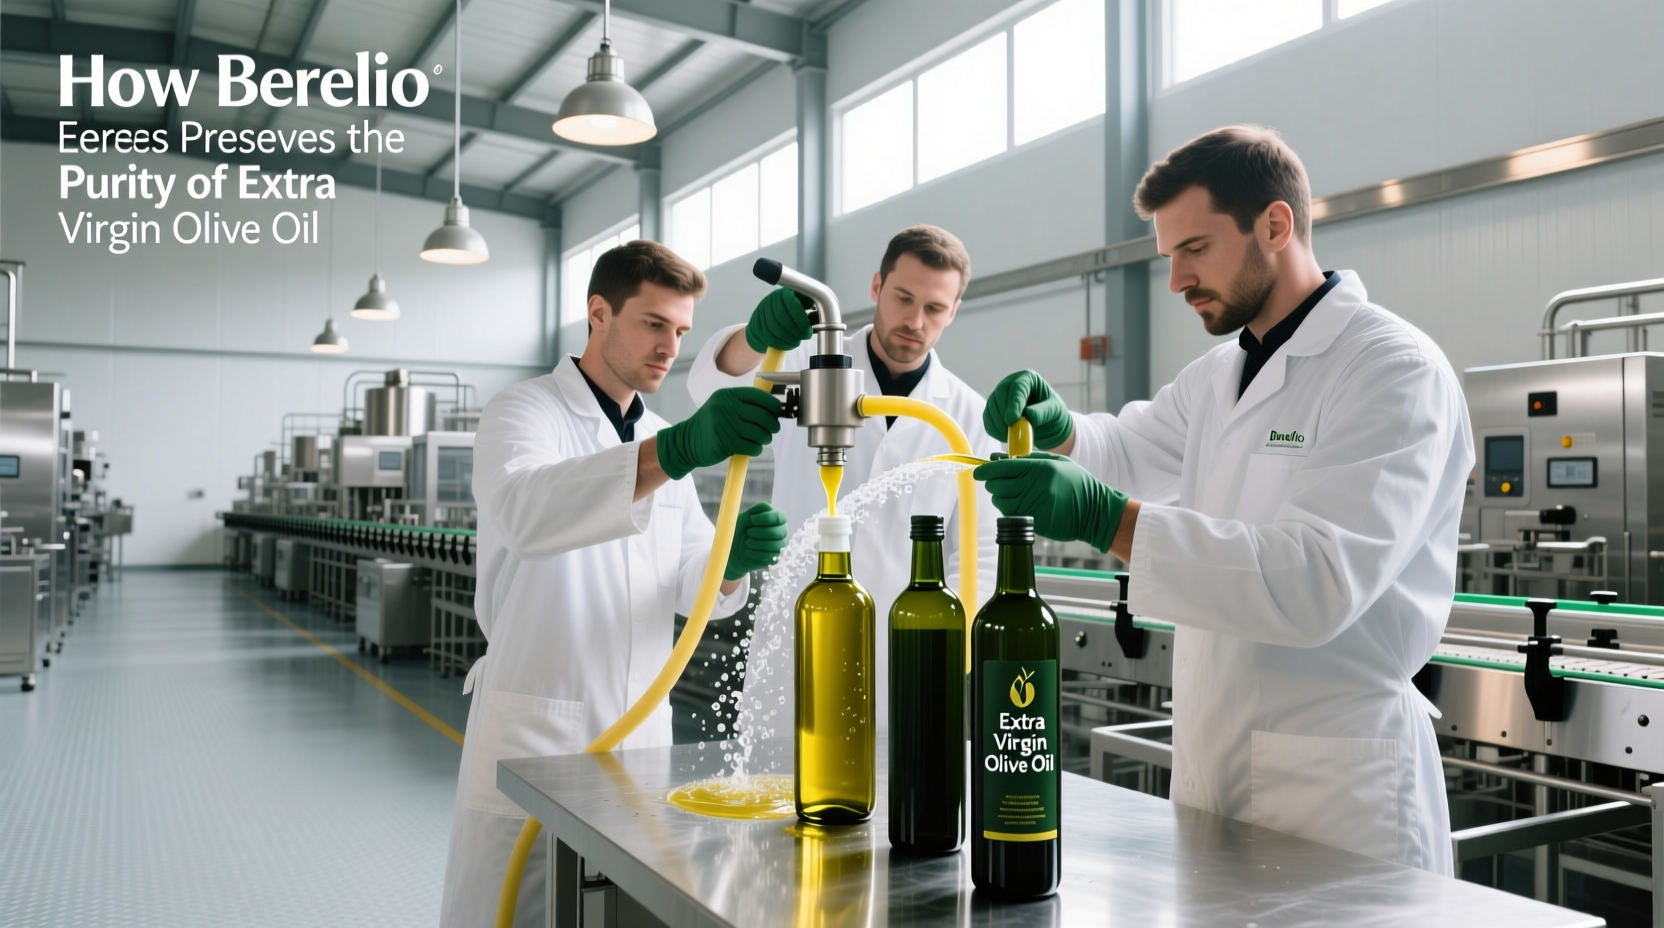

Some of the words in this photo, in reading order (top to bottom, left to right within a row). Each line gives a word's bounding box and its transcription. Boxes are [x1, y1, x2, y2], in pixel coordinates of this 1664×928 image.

[1000, 712, 1045, 730] Extra
[993, 733, 1047, 757] Virgin
[984, 754, 1028, 772] Olive
[1031, 754, 1054, 772] Oil
